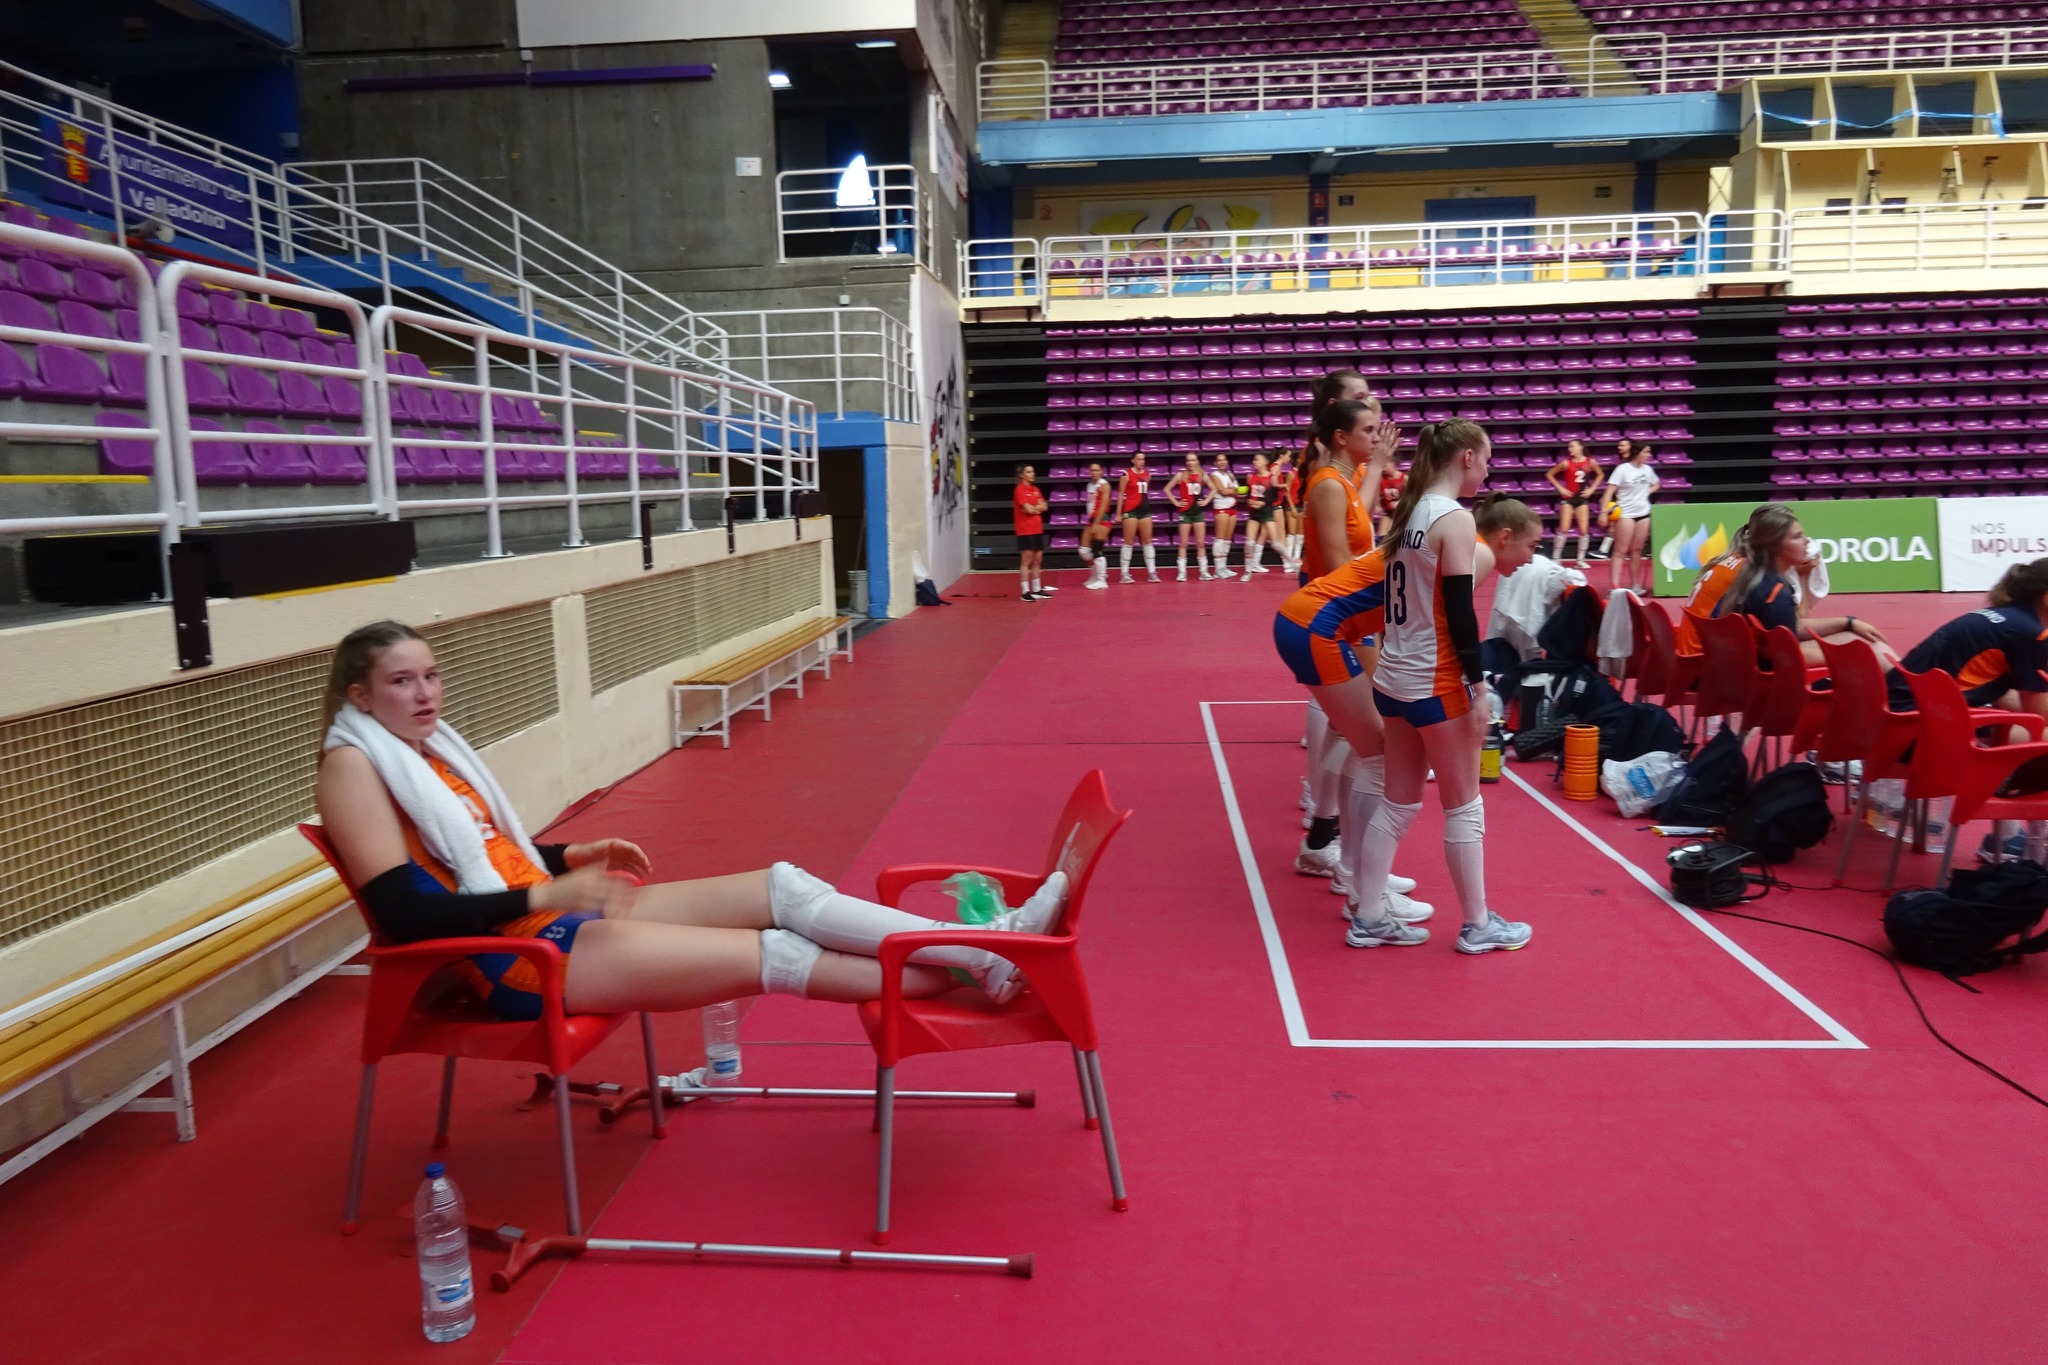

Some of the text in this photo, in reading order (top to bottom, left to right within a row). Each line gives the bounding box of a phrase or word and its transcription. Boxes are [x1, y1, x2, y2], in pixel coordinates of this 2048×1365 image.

[100, 144, 218, 195] Ayuntamiento
[128, 187, 226, 230] Valladolid
[1574, 470, 1586, 483] 2
[1971, 522, 2007, 535] NOS
[1817, 536, 1934, 563] DROLA
[1385, 560, 1408, 626] 13
